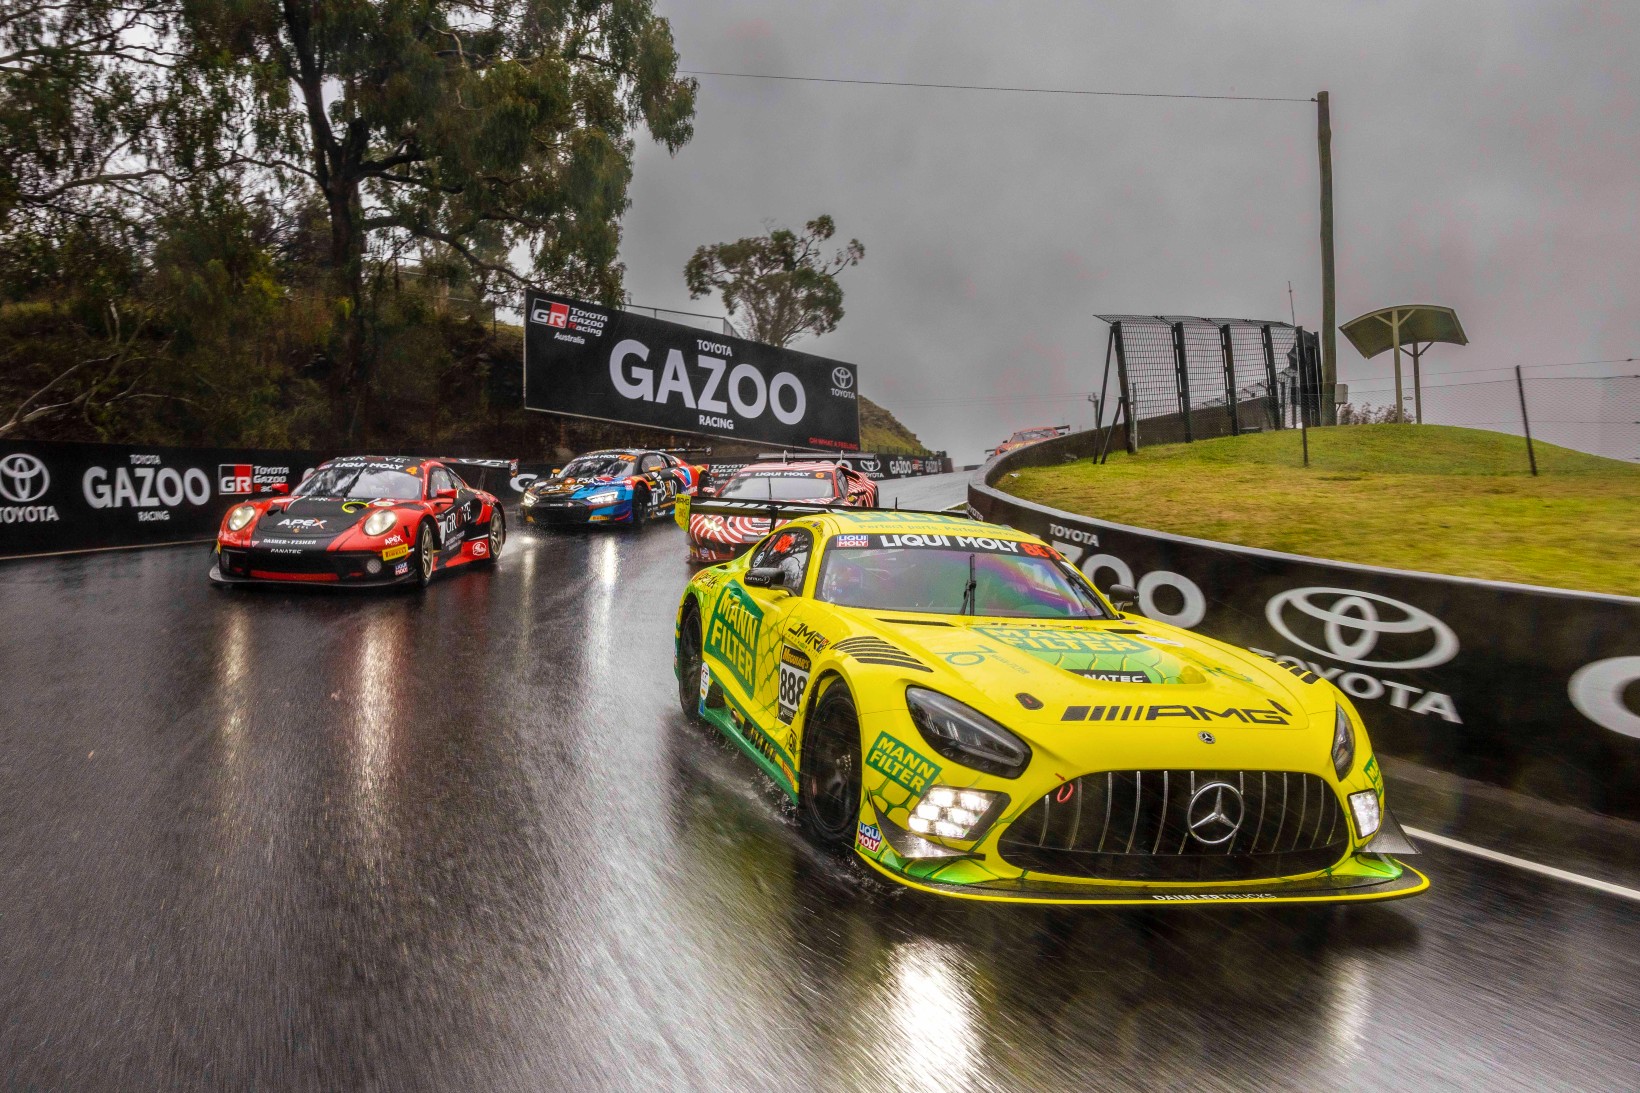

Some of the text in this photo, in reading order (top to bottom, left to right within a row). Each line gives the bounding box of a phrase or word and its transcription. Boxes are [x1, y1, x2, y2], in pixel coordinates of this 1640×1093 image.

[533, 309, 564, 327] GR
[569, 315, 604, 328] GAZOO
[571, 307, 608, 321] TOYOTA
[568, 322, 602, 336] Racing
[554, 332, 585, 344] Australia
[697, 339, 733, 357] TOYOTA
[609, 339, 806, 425] GAZOO
[831, 388, 855, 399] TOYOTA
[699, 415, 734, 430] RACING
[130, 454, 161, 464] TOYOTA
[254, 466, 289, 474] TOYOTA
[221, 476, 251, 492] GR
[253, 475, 286, 483] GAZOO
[82, 466, 211, 509] GAZOO
[138, 511, 170, 521] RACING
[277, 519, 327, 529] APEX
[1050, 523, 1099, 547] TOYOTA
[880, 535, 1018, 552] LIQUI MOLY
[718, 587, 758, 651] MANN
[982, 628, 1122, 641] MANN
[1004, 637, 1141, 651] FILTER
[711, 618, 753, 687] FILTER
[780, 668, 808, 705] 888
[1083, 674, 1144, 683] NATEC
[1145, 705, 1290, 725] AMG
[877, 737, 935, 779] MANN
[870, 750, 925, 793] FILTER
[860, 822, 882, 842] LIQUI
[858, 834, 880, 853] MOLY
